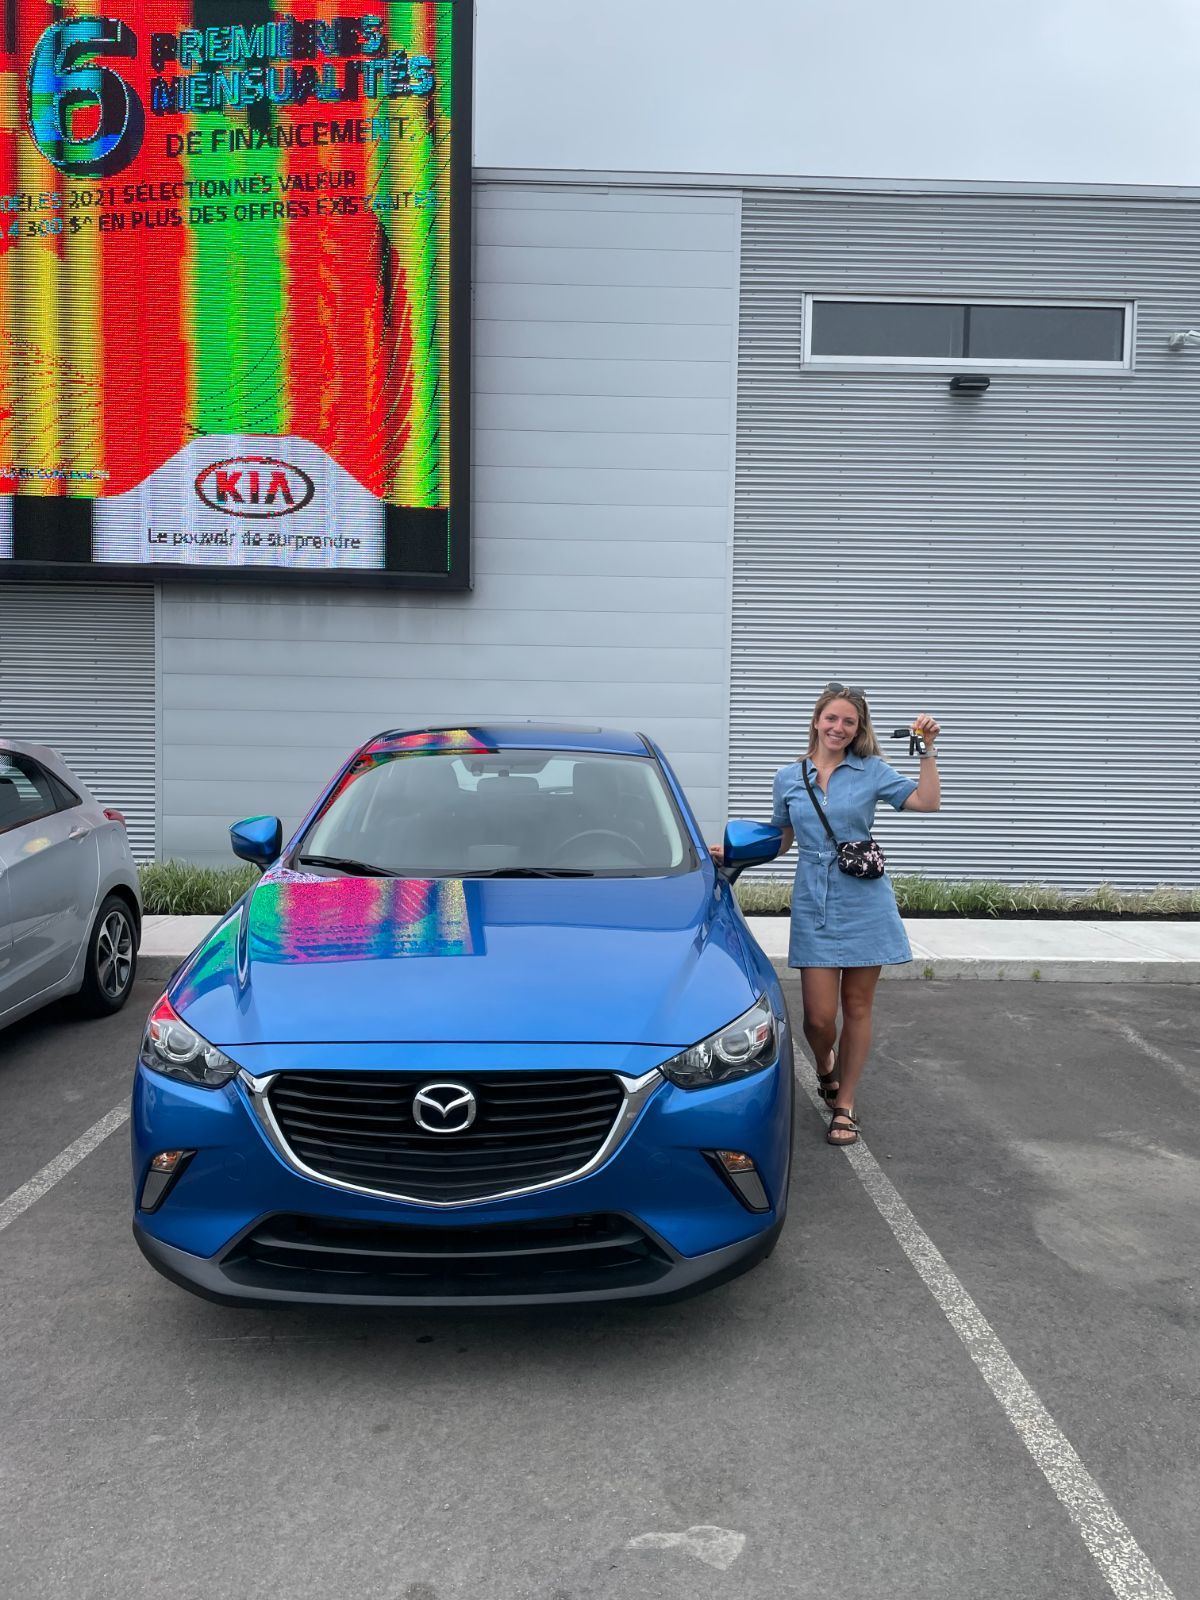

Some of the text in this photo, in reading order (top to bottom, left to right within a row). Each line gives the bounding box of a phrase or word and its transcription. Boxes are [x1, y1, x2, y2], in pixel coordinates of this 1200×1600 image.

[26, 17, 146, 178] 6
[151, 50, 436, 115] MENSUALITÉS
[165, 131, 202, 158] DE
[69, 186, 115, 209] 2021
[278, 170, 356, 193] VALEUR
[26, 217, 63, 238] 300
[99, 211, 125, 233] EN
[131, 207, 183, 230] PLUS
[189, 204, 227, 224] DES
[233, 198, 309, 222] OFFRES
[216, 471, 296, 505] KIA
[148, 528, 168, 544] Le
[241, 530, 263, 546] de
[268, 532, 361, 550] surprendre
